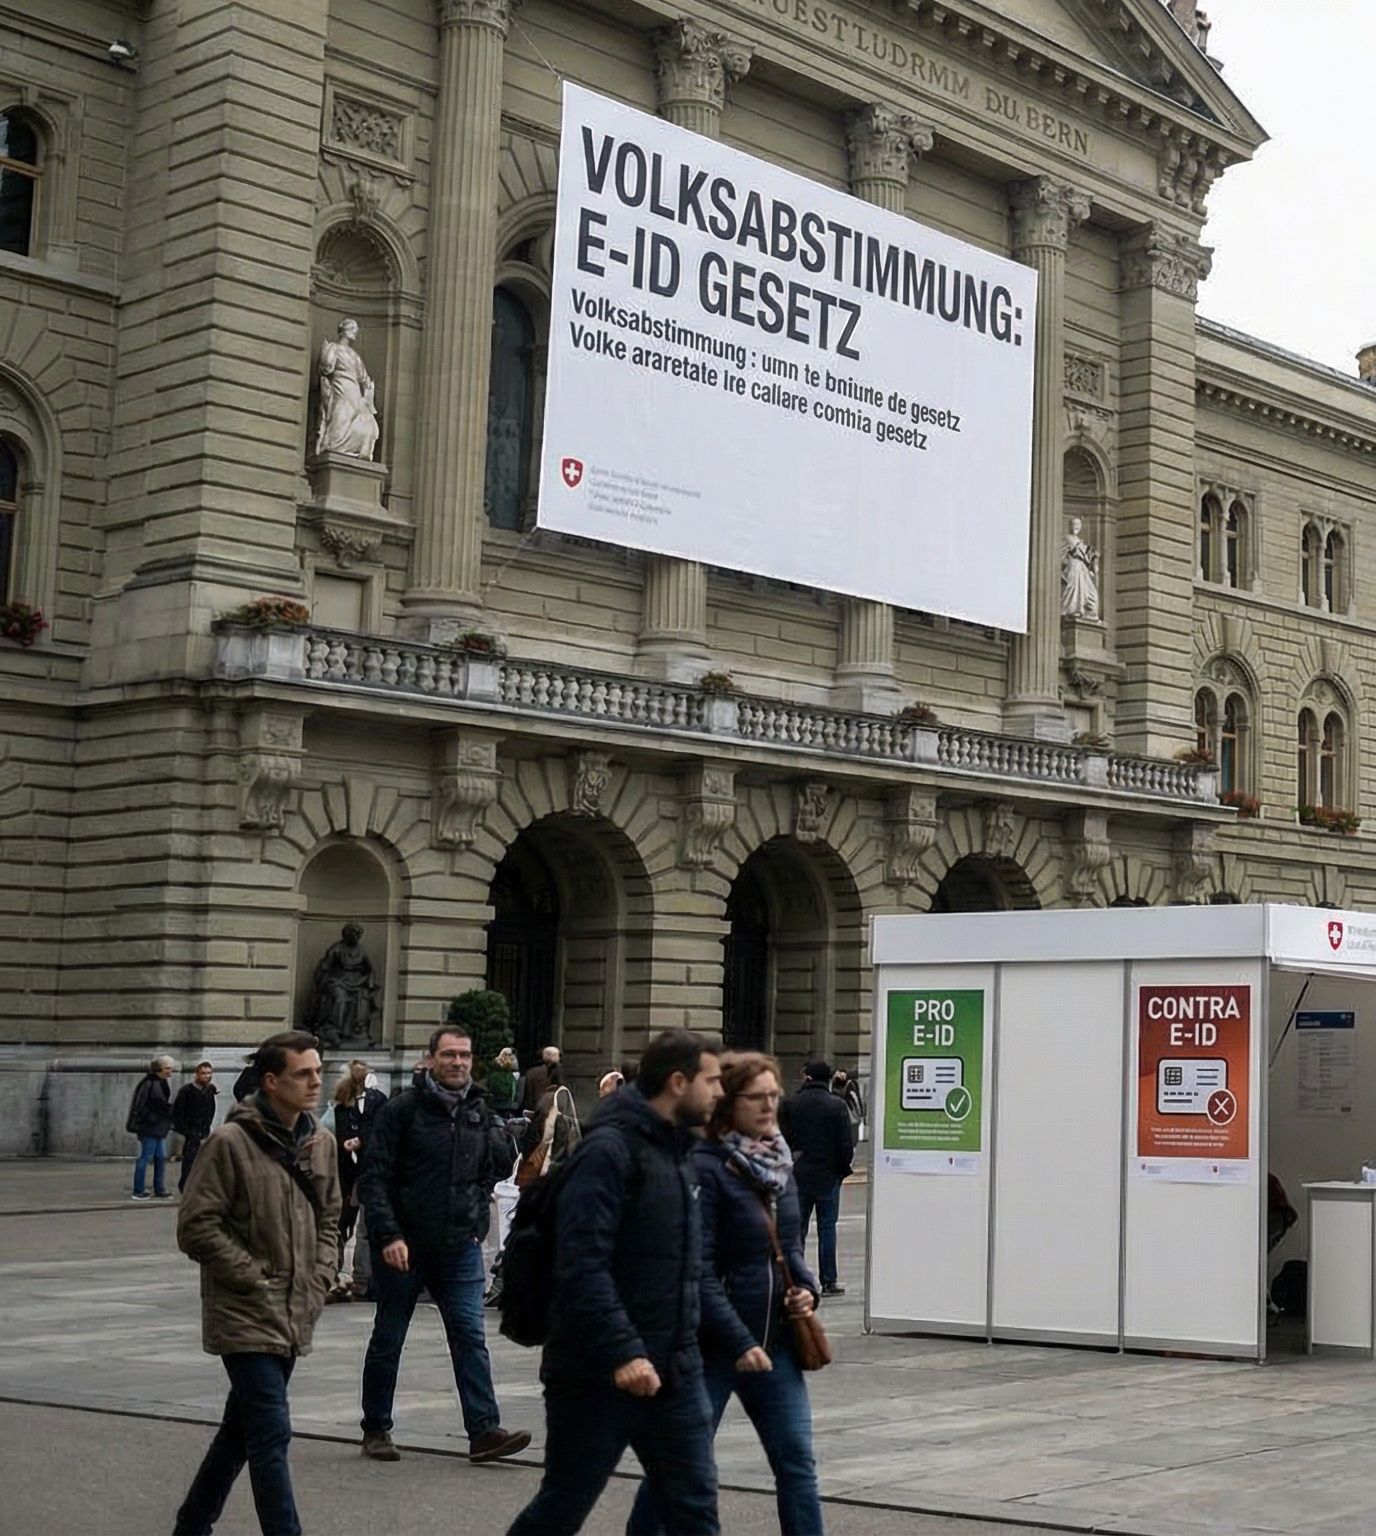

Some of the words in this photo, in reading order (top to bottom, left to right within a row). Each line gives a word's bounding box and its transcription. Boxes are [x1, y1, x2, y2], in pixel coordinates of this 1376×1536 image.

[1026, 106, 1089, 155] BERN
[581, 125, 1022, 347] VOLKSABSTIMMUNG:
[577, 207, 681, 298] E-ID
[699, 251, 862, 361] GESETZ
[571, 288, 747, 370] Volksabstimmung
[804, 363, 820, 387] te
[887, 392, 907, 416] de
[911, 402, 961, 432] gesetz
[570, 321, 627, 361] Volke
[876, 421, 928, 450] gesetz
[914, 1000, 955, 1021] PRO
[1147, 996, 1241, 1020] CONTRA
[913, 1024, 955, 1046] E-ID
[1170, 1023, 1217, 1046] E-ID
